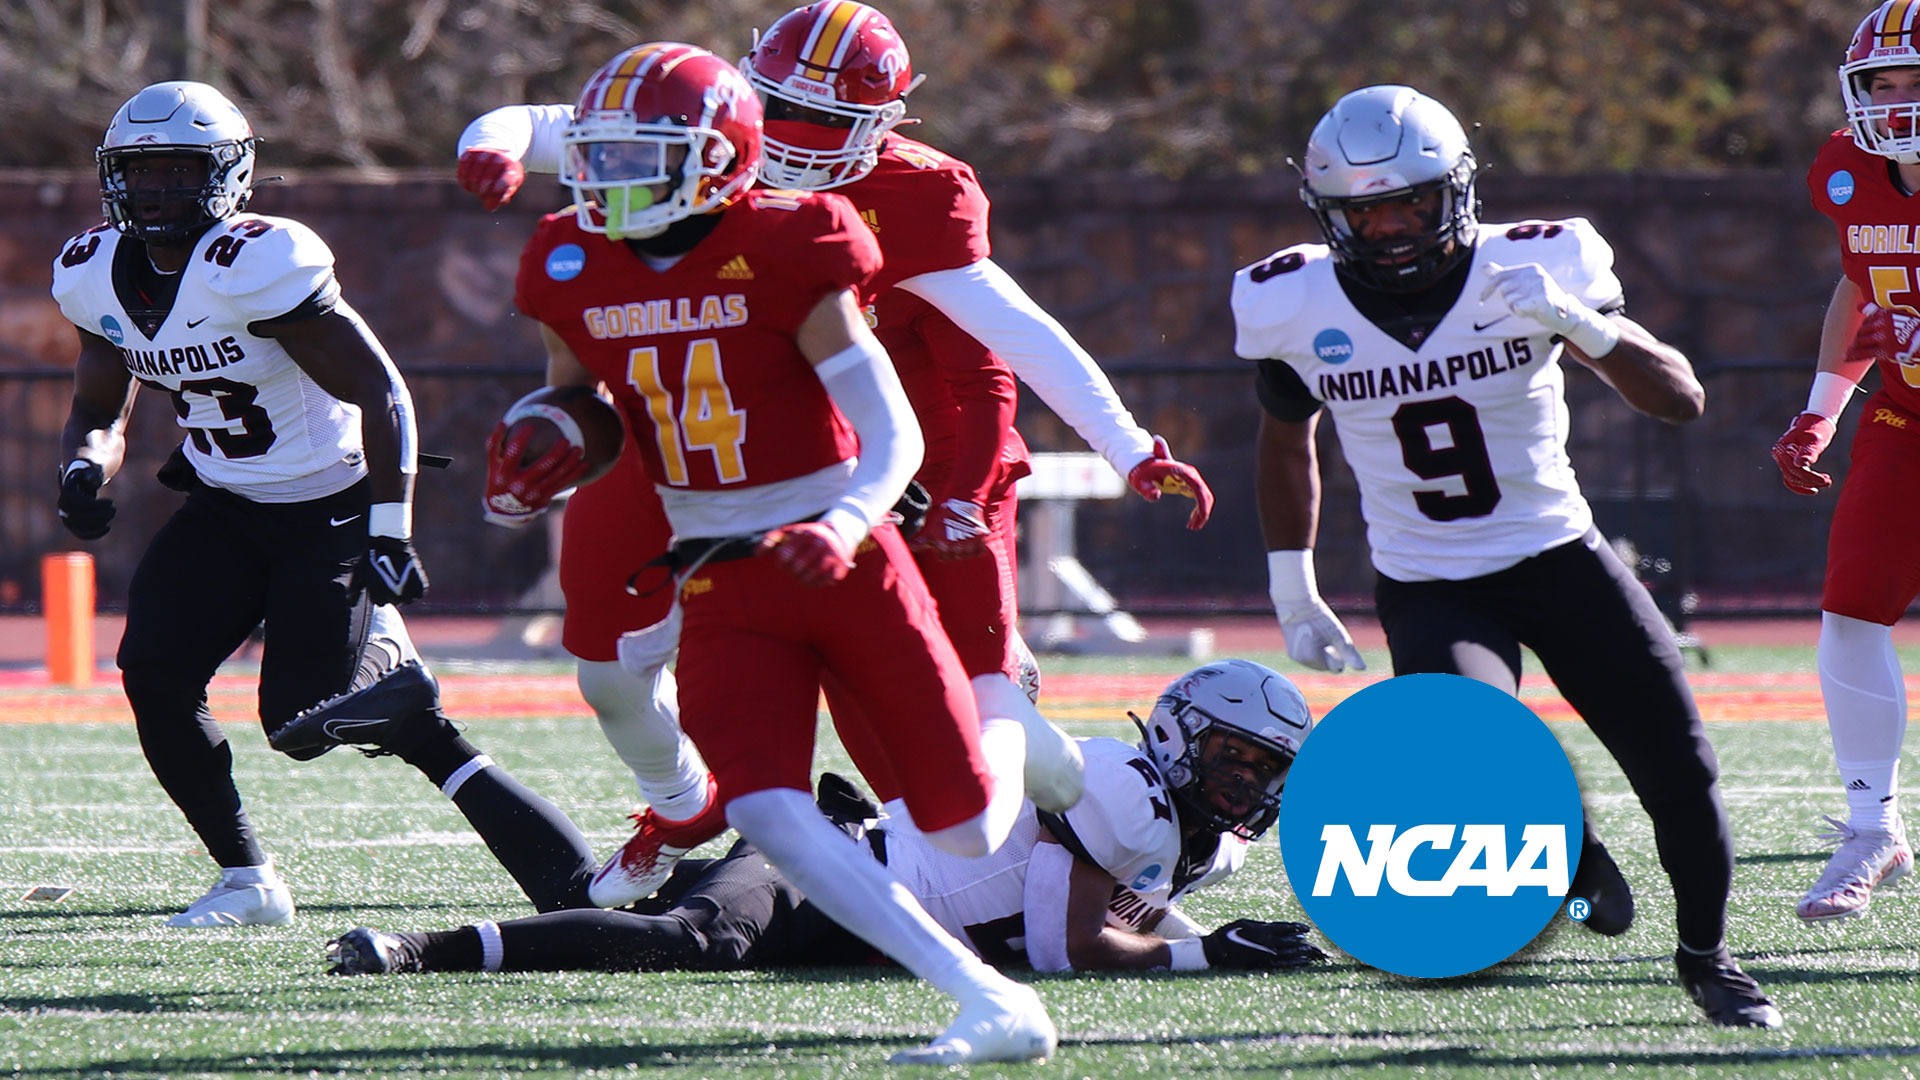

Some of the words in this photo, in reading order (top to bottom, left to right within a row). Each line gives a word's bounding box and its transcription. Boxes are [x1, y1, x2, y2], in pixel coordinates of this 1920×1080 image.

[1831, 186, 1852, 197] NCAA
[204, 219, 274, 268] 23
[1250, 252, 1306, 283] 9
[583, 294, 749, 340] GORILLAS
[122, 335, 246, 377] DIANAPOLIS
[1318, 343, 1352, 358] NCAA
[1318, 336, 1533, 401] INDIANAPOLIS
[626, 338, 747, 487] 14
[1872, 408, 1908, 430] Pitt
[1390, 394, 1502, 523] 9
[1125, 756, 1173, 824] 27
